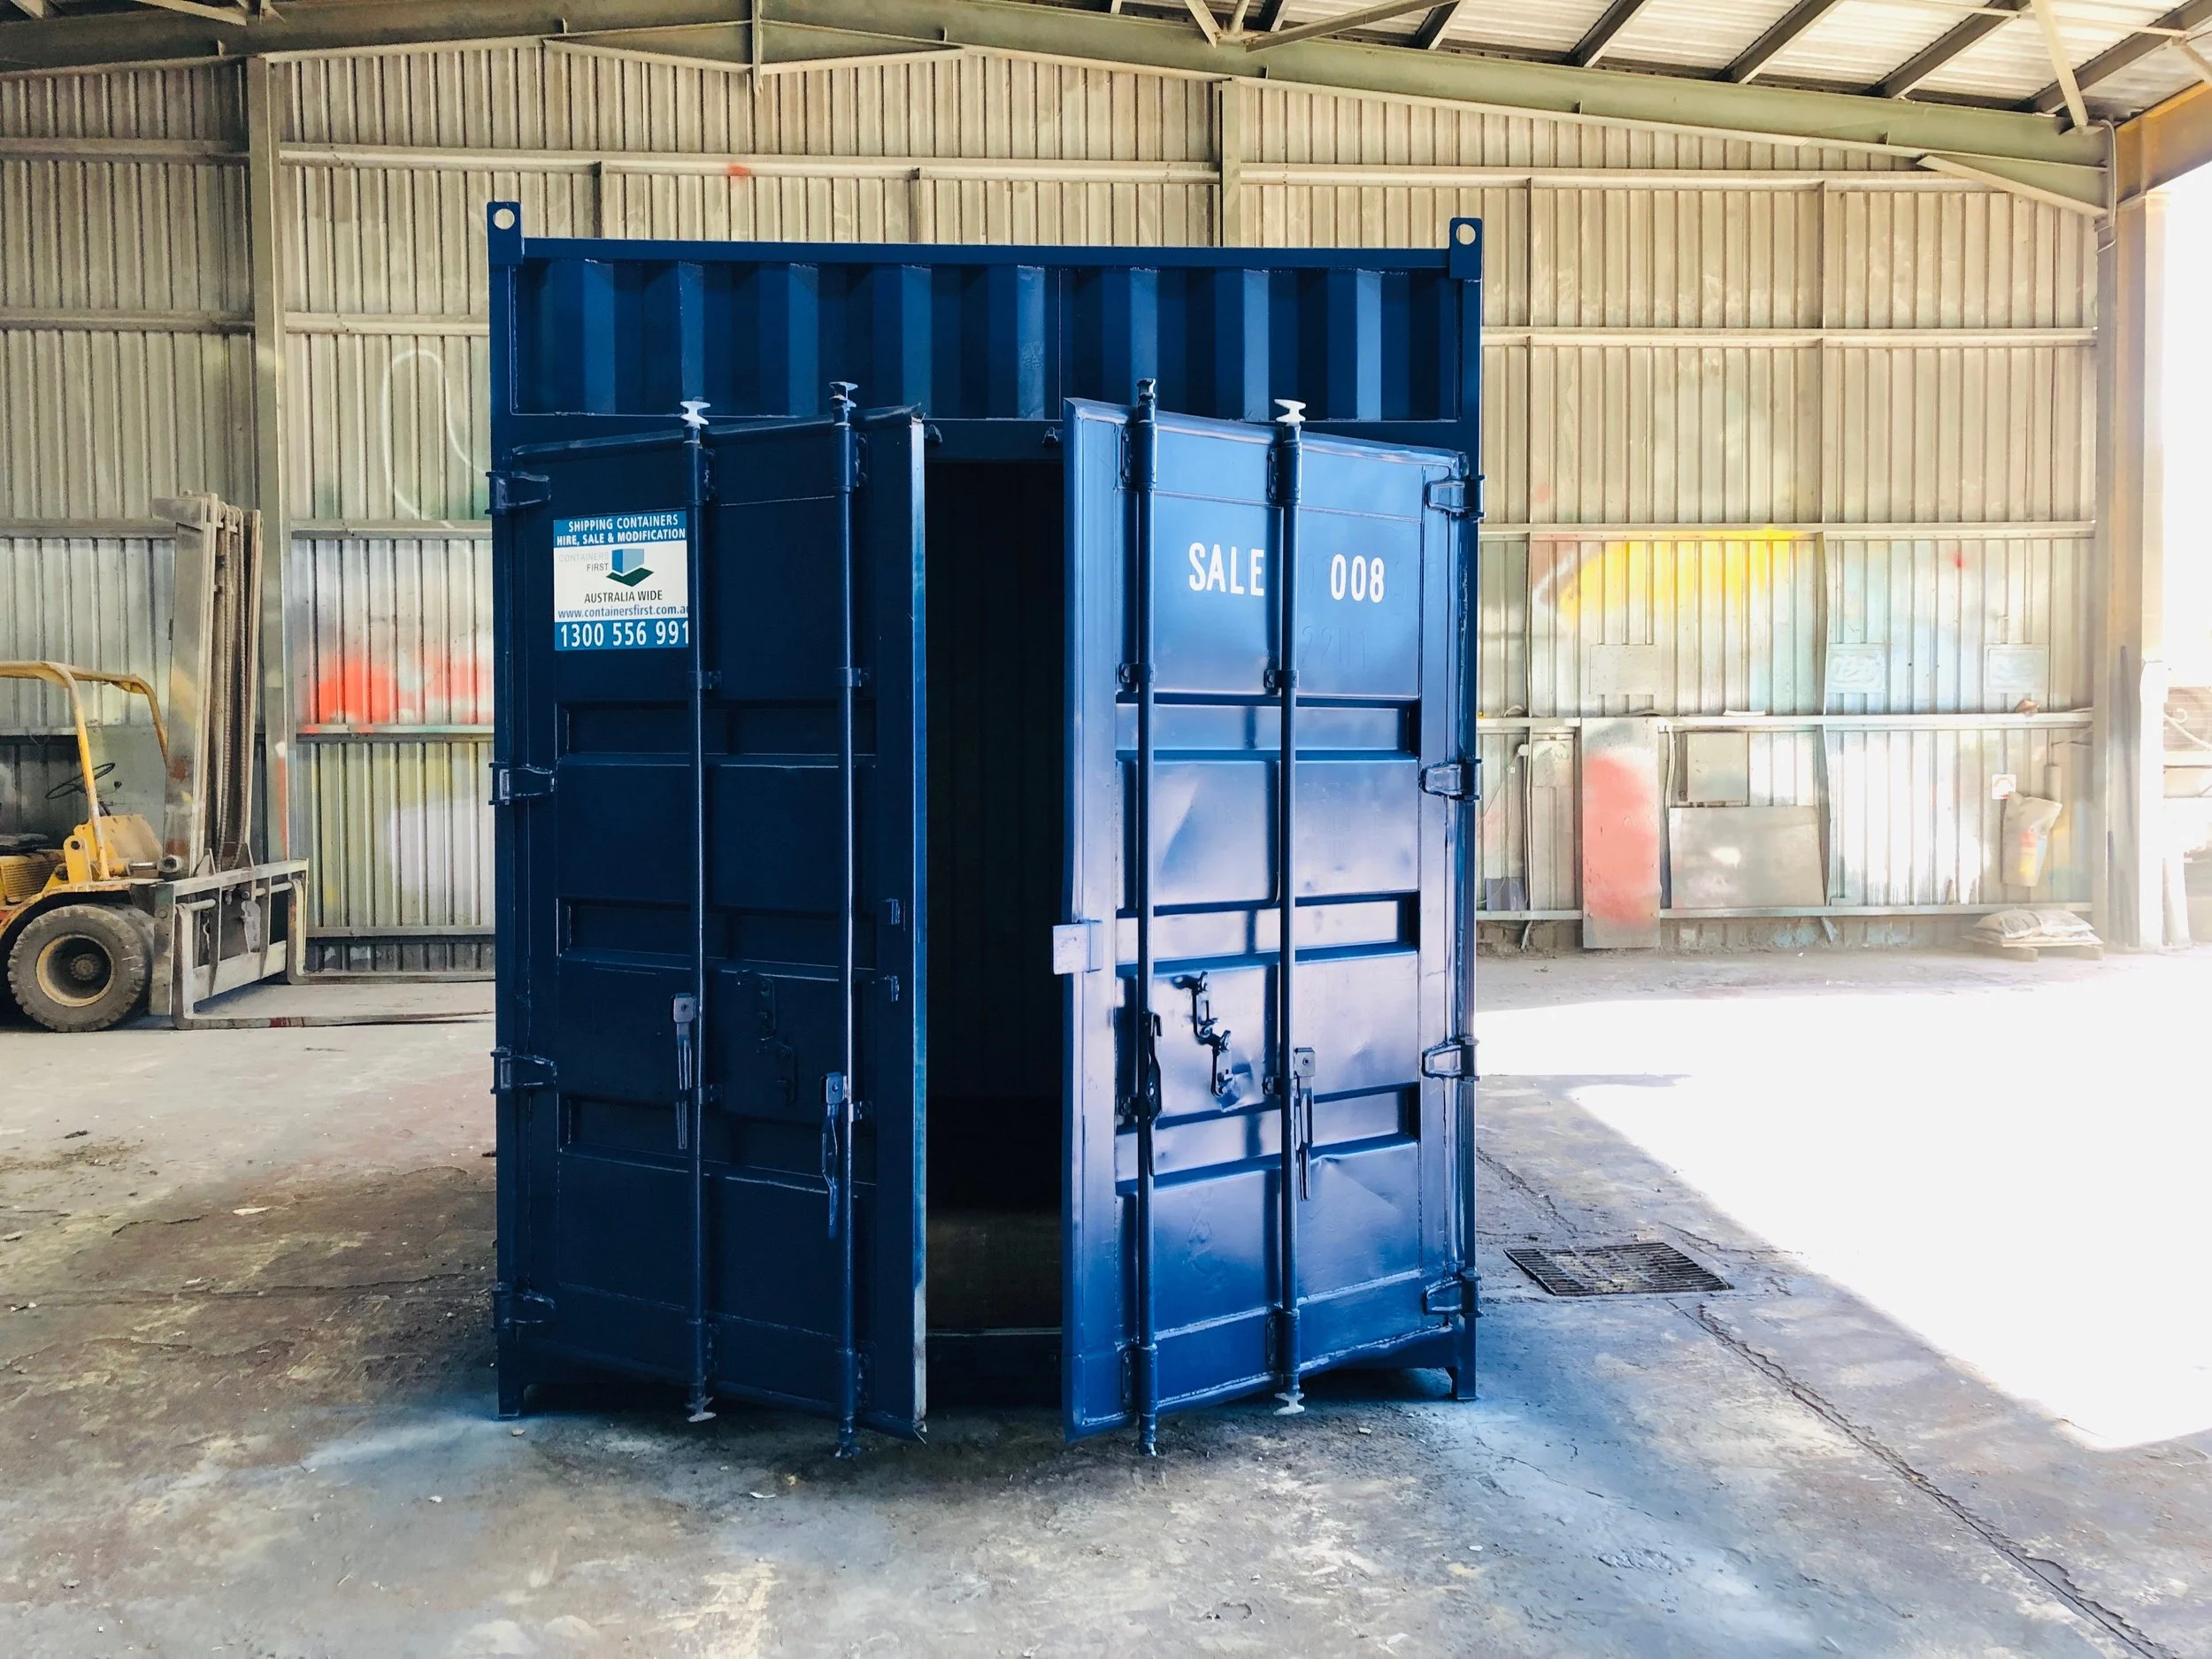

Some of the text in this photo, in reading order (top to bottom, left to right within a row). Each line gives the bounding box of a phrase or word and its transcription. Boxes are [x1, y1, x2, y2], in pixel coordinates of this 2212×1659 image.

[568, 513, 679, 533] SHIPPING CONTAINERS
[557, 528, 686, 547] HIRE, SALE & MODIFICATION
[558, 551, 610, 563] CONTAINERS
[586, 563, 610, 572] FIRST
[1188, 541, 1265, 596] SALE
[1331, 553, 1385, 603] 008
[584, 590, 663, 603] AUSTRALIA WIDE
[557, 603, 688, 618] www.containersfirst.com.a
[561, 620, 689, 648] 1300 556 991
